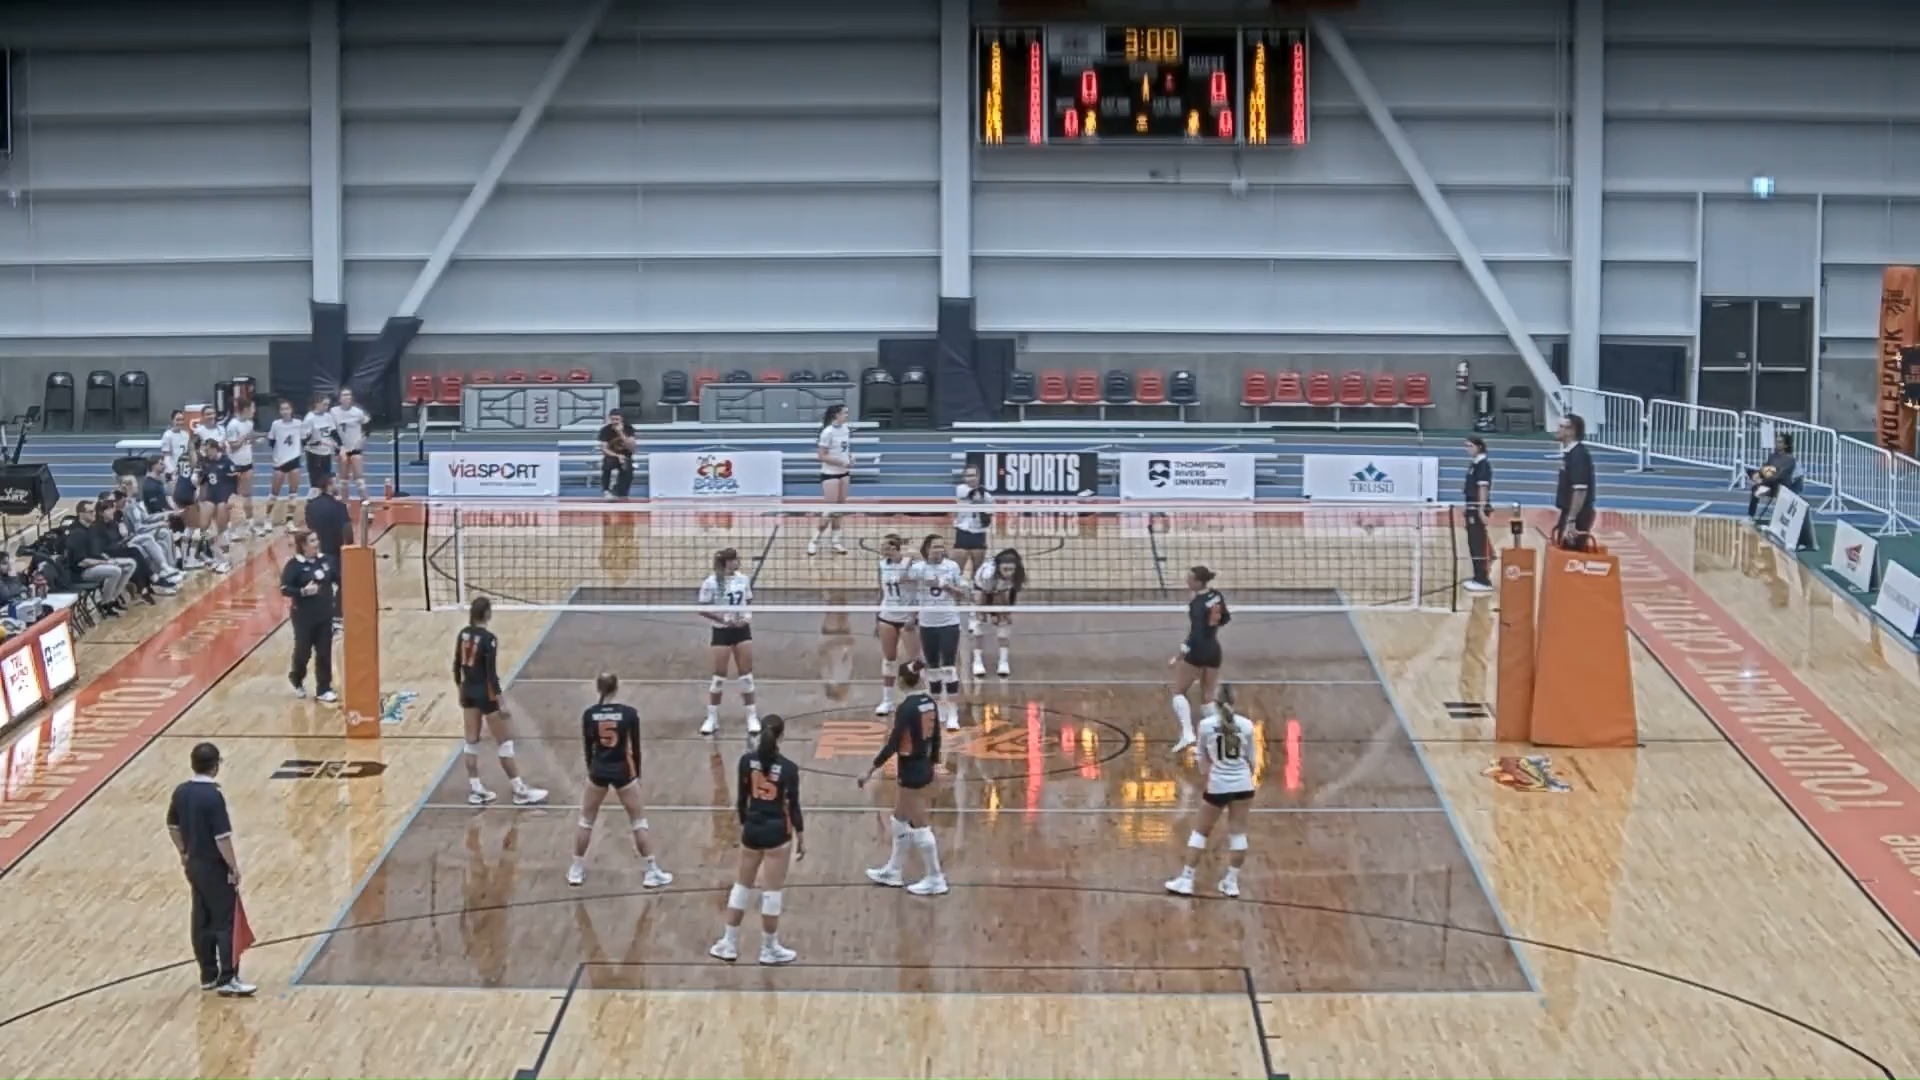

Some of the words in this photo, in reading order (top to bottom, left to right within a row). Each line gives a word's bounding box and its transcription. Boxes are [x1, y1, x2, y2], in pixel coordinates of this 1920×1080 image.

[1125, 27, 1178, 58] 3:00
[283, 433, 294, 447] 4
[447, 459, 541, 479] viaSPORT
[983, 453, 998, 491] U
[1005, 453, 1080, 491] SPORTS
[1174, 461, 1226, 469] THOMPSON
[1174, 469, 1207, 477] RIVERS
[1174, 479, 1228, 488] UNIVERSITY
[1349, 479, 1395, 493] TRUSU
[598, 720, 619, 748] 5
[1686, 657, 1903, 812] TOURNAMENT
